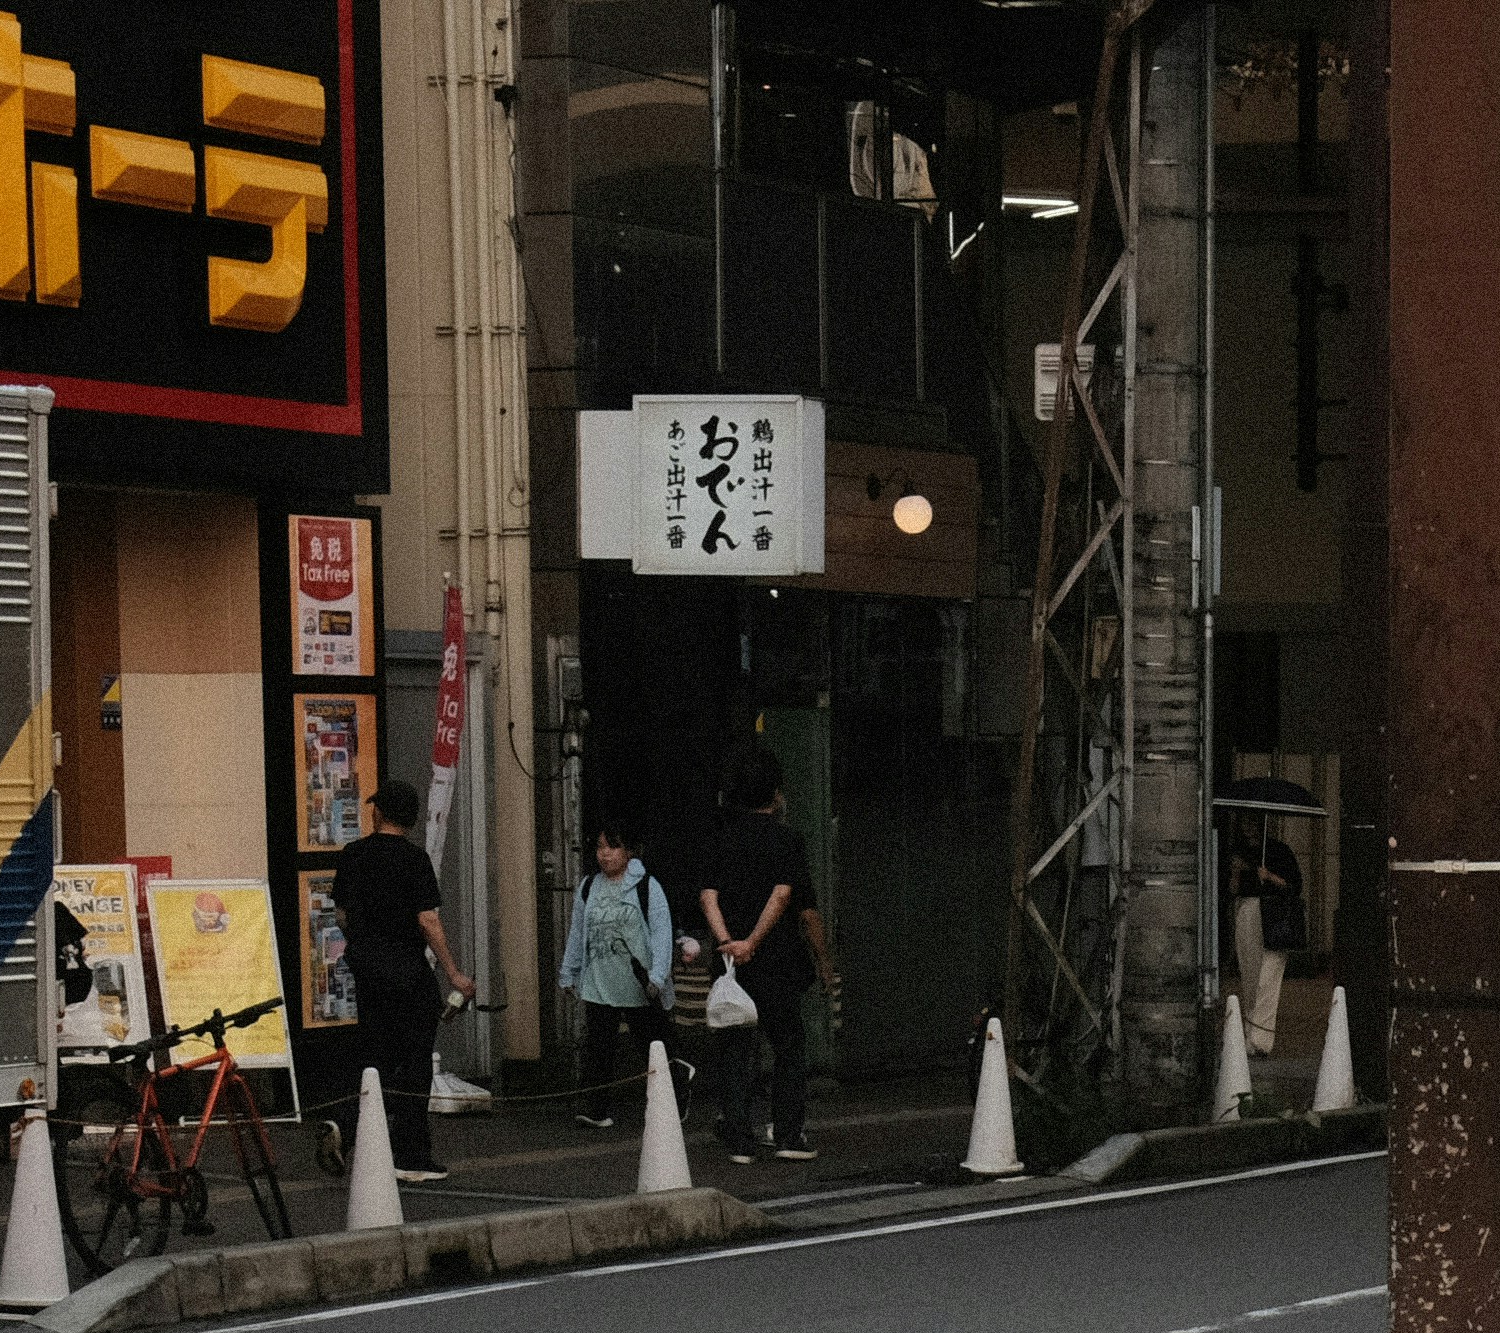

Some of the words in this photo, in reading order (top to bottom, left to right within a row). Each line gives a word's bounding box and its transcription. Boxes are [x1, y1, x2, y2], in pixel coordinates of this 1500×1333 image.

[666, 420, 688, 550] あご出汁一番
[695, 414, 745, 555] おでん
[302, 563, 322, 583] Tax
[324, 565, 350, 584] Free
[309, 536, 342, 562] 免税
